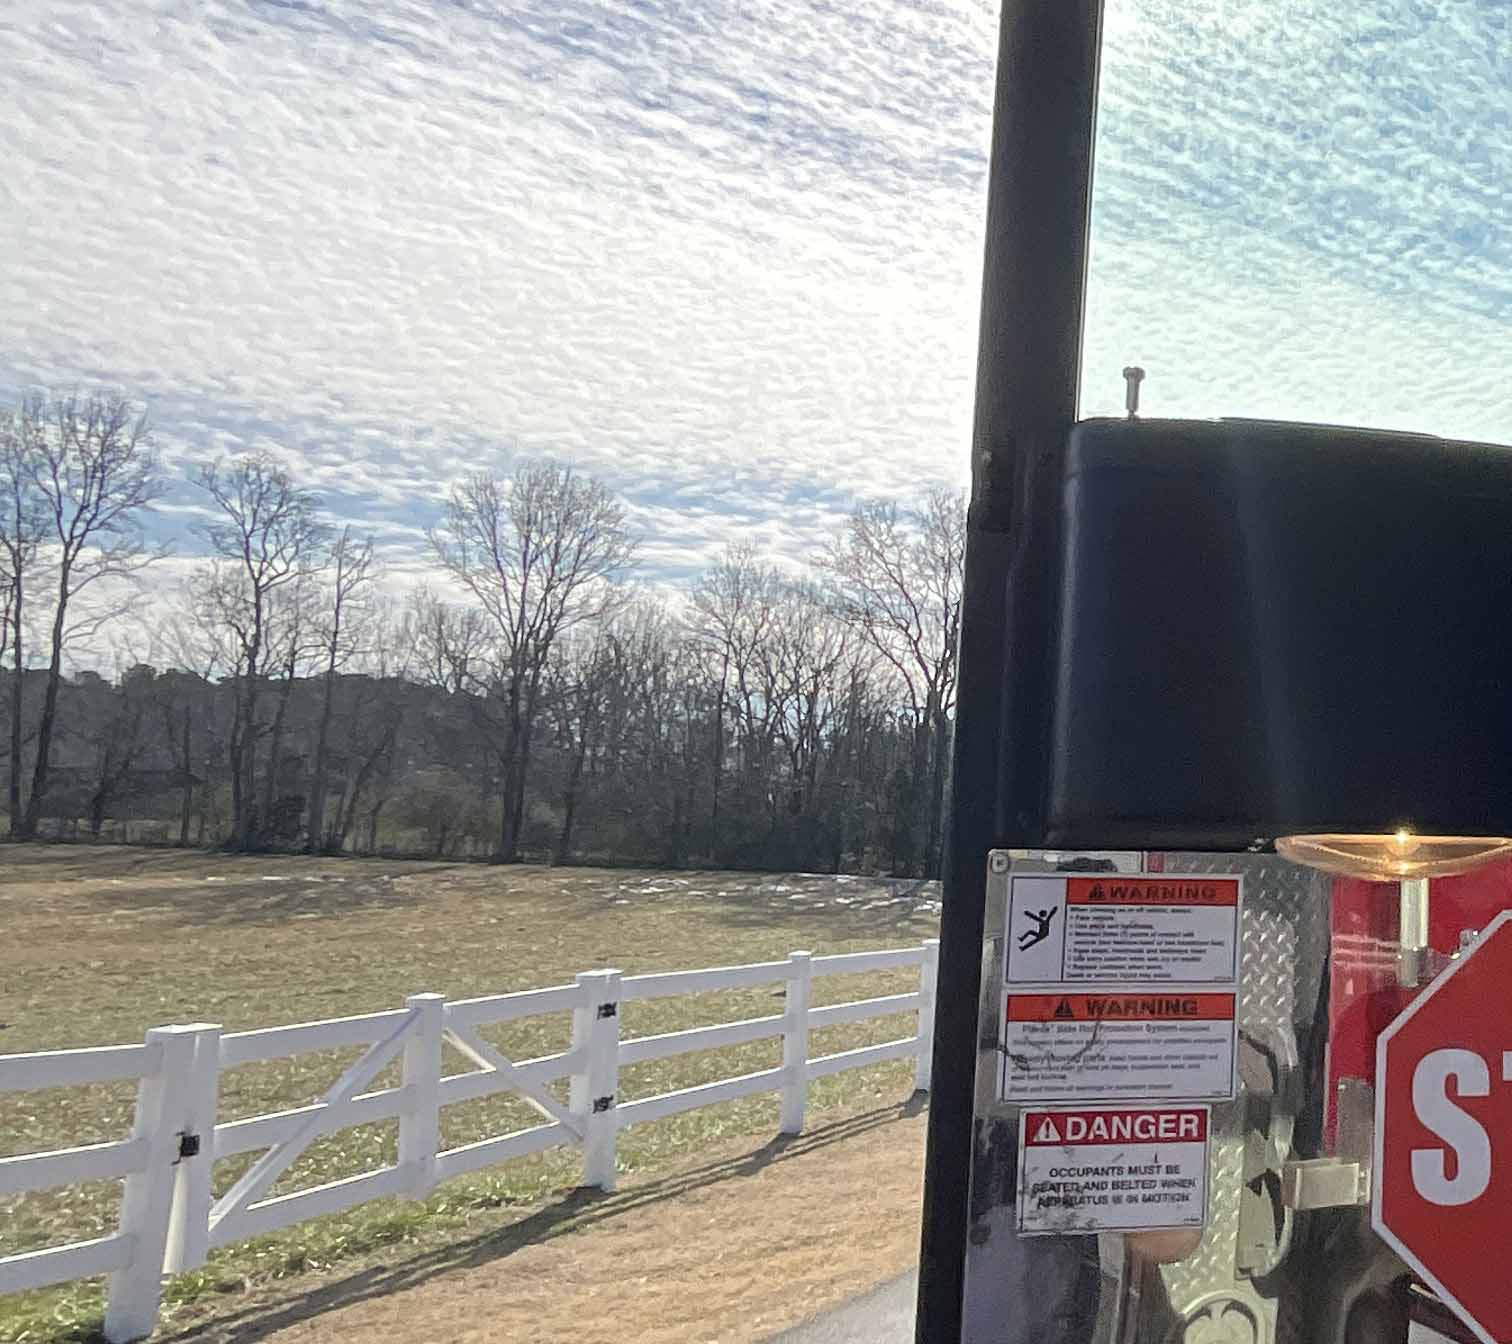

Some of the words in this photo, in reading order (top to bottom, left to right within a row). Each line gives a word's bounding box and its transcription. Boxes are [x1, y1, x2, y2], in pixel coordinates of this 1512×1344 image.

[1110, 885, 1217, 899] WARNING
[1087, 999, 1198, 1016] WARNING
[1066, 1113, 1199, 1141] DANGER
[1049, 1166, 1124, 1178] OCCUPANTS
[1128, 1165, 1162, 1176] MUST
[1165, 1164, 1181, 1174] BE
[1033, 1181, 1079, 1194] SEATED
[1083, 1180, 1108, 1191] AND
[1111, 1179, 1157, 1190] BELTED
[1160, 1178, 1196, 1188] WHEN
[1141, 1192, 1190, 1203] MOTION
